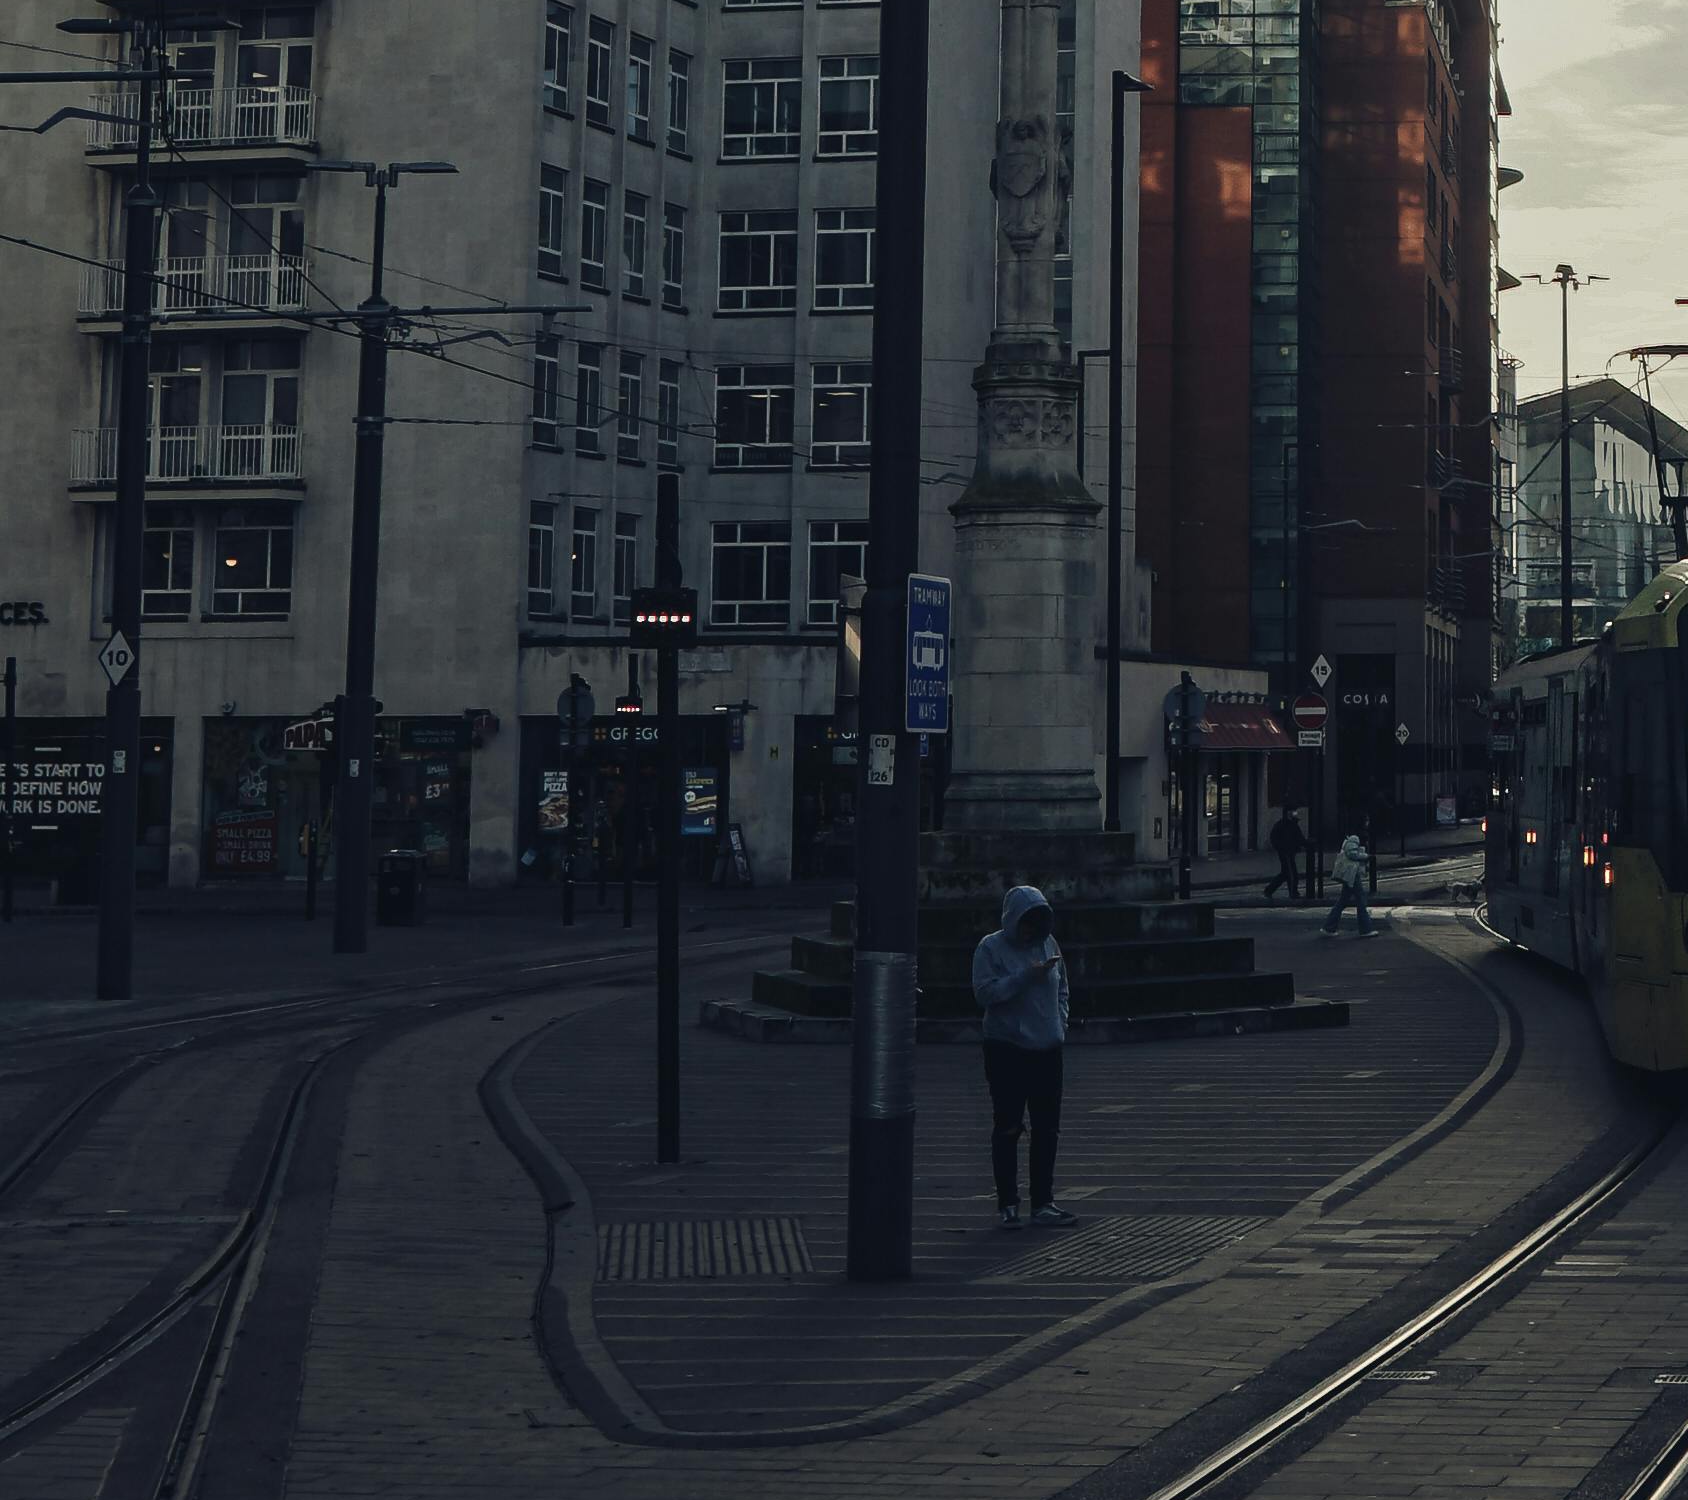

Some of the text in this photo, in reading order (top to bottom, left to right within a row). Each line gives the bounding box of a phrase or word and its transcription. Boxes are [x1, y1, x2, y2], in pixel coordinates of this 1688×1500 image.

[913, 586, 946, 607] TRAMWAY
[107, 650, 129, 667] 10
[1316, 666, 1328, 675] 15
[909, 679, 946, 698] LOOK BOTH
[1343, 694, 1388, 705] COSA
[918, 703, 937, 721] WAYS
[875, 738, 889, 748] CD
[34, 763, 81, 777] START
[86, 763, 105, 777] TO
[68, 781, 102, 795] HOW
[544, 782, 568, 792] PIZZA
[38, 800, 52, 814] IS
[57, 800, 101, 814] DONE.
[216, 828, 244, 838] SMALL
